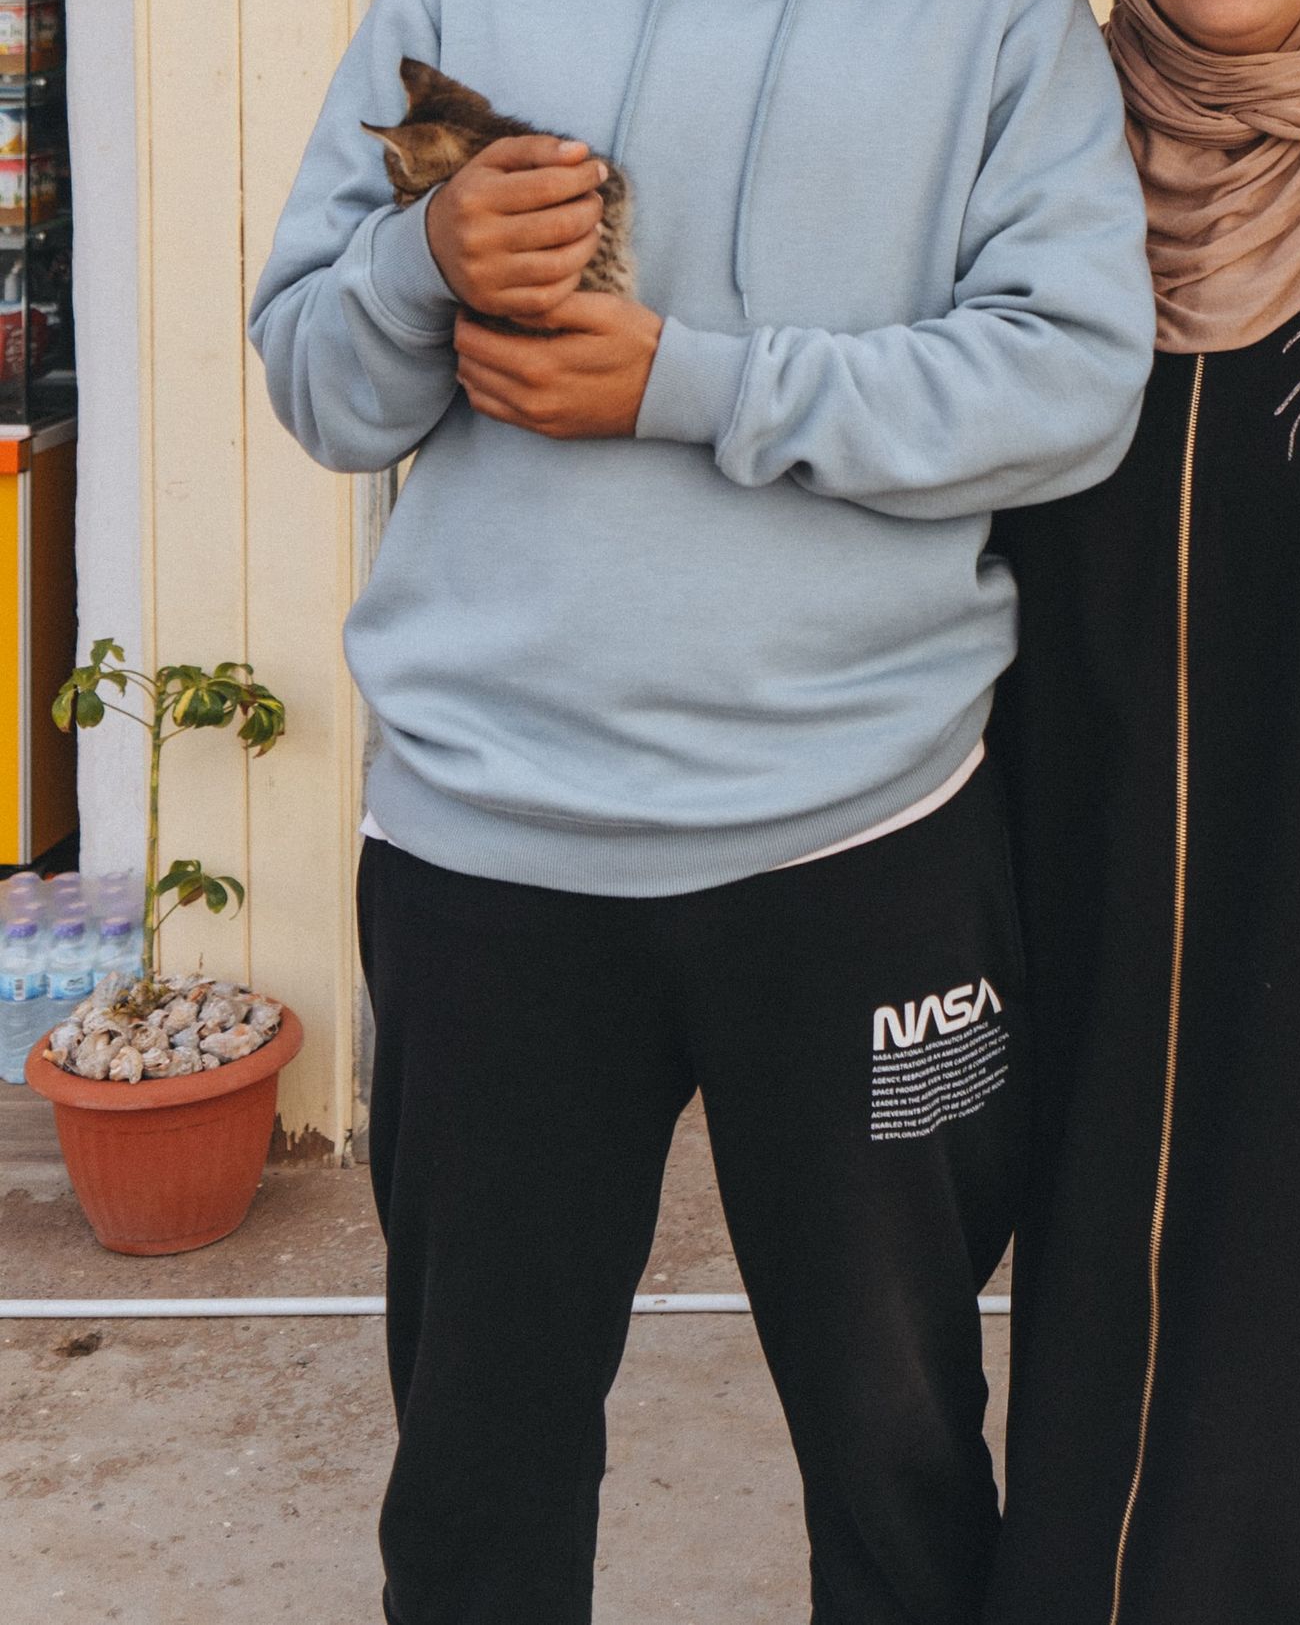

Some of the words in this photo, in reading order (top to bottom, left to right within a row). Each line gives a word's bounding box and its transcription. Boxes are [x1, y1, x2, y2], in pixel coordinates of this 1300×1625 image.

[873, 977, 1002, 1051] NASA
[872, 1099, 898, 1107] LEADER
[908, 1096, 921, 1104] THE
[871, 1121, 903, 1130] ENABLED
[904, 1119, 917, 1127] THE
